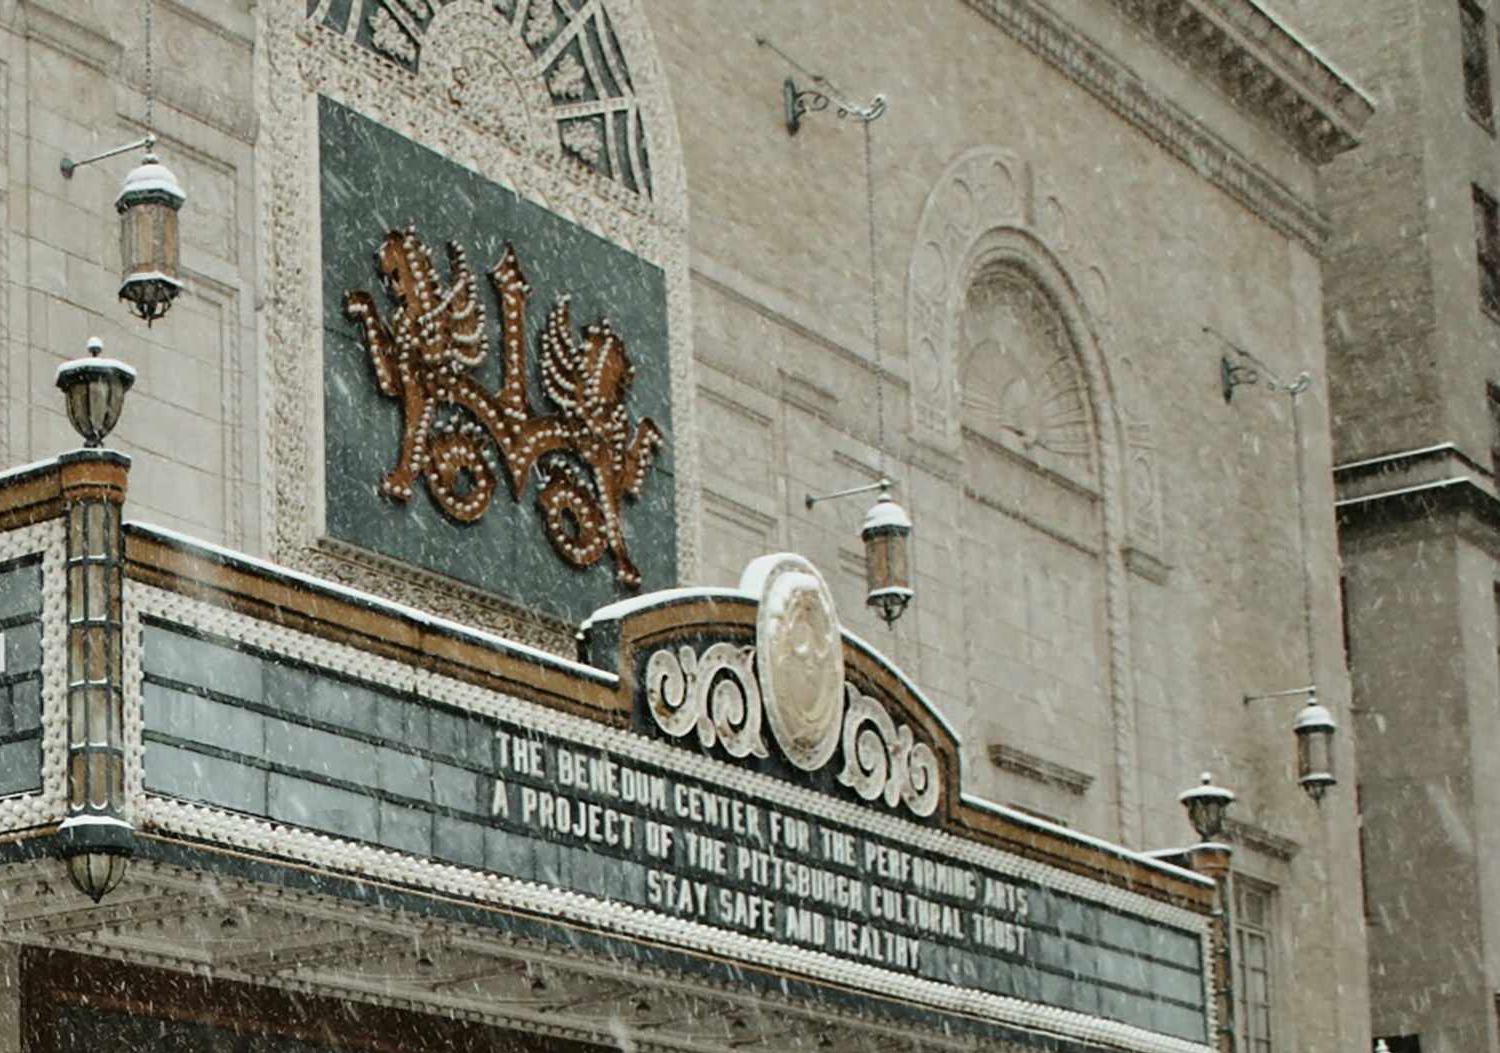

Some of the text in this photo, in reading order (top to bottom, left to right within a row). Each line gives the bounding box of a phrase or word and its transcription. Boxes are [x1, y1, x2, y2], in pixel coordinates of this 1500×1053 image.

[492, 779, 1026, 956] A PROJECT OF THE PITTSBURGH CULTURAL TRUST
[495, 731, 1028, 916] THE BENEDUM CENTER FOR THE PERFORMING ARTS
[647, 870, 920, 970] STAY SAFE AND HEALTHY
